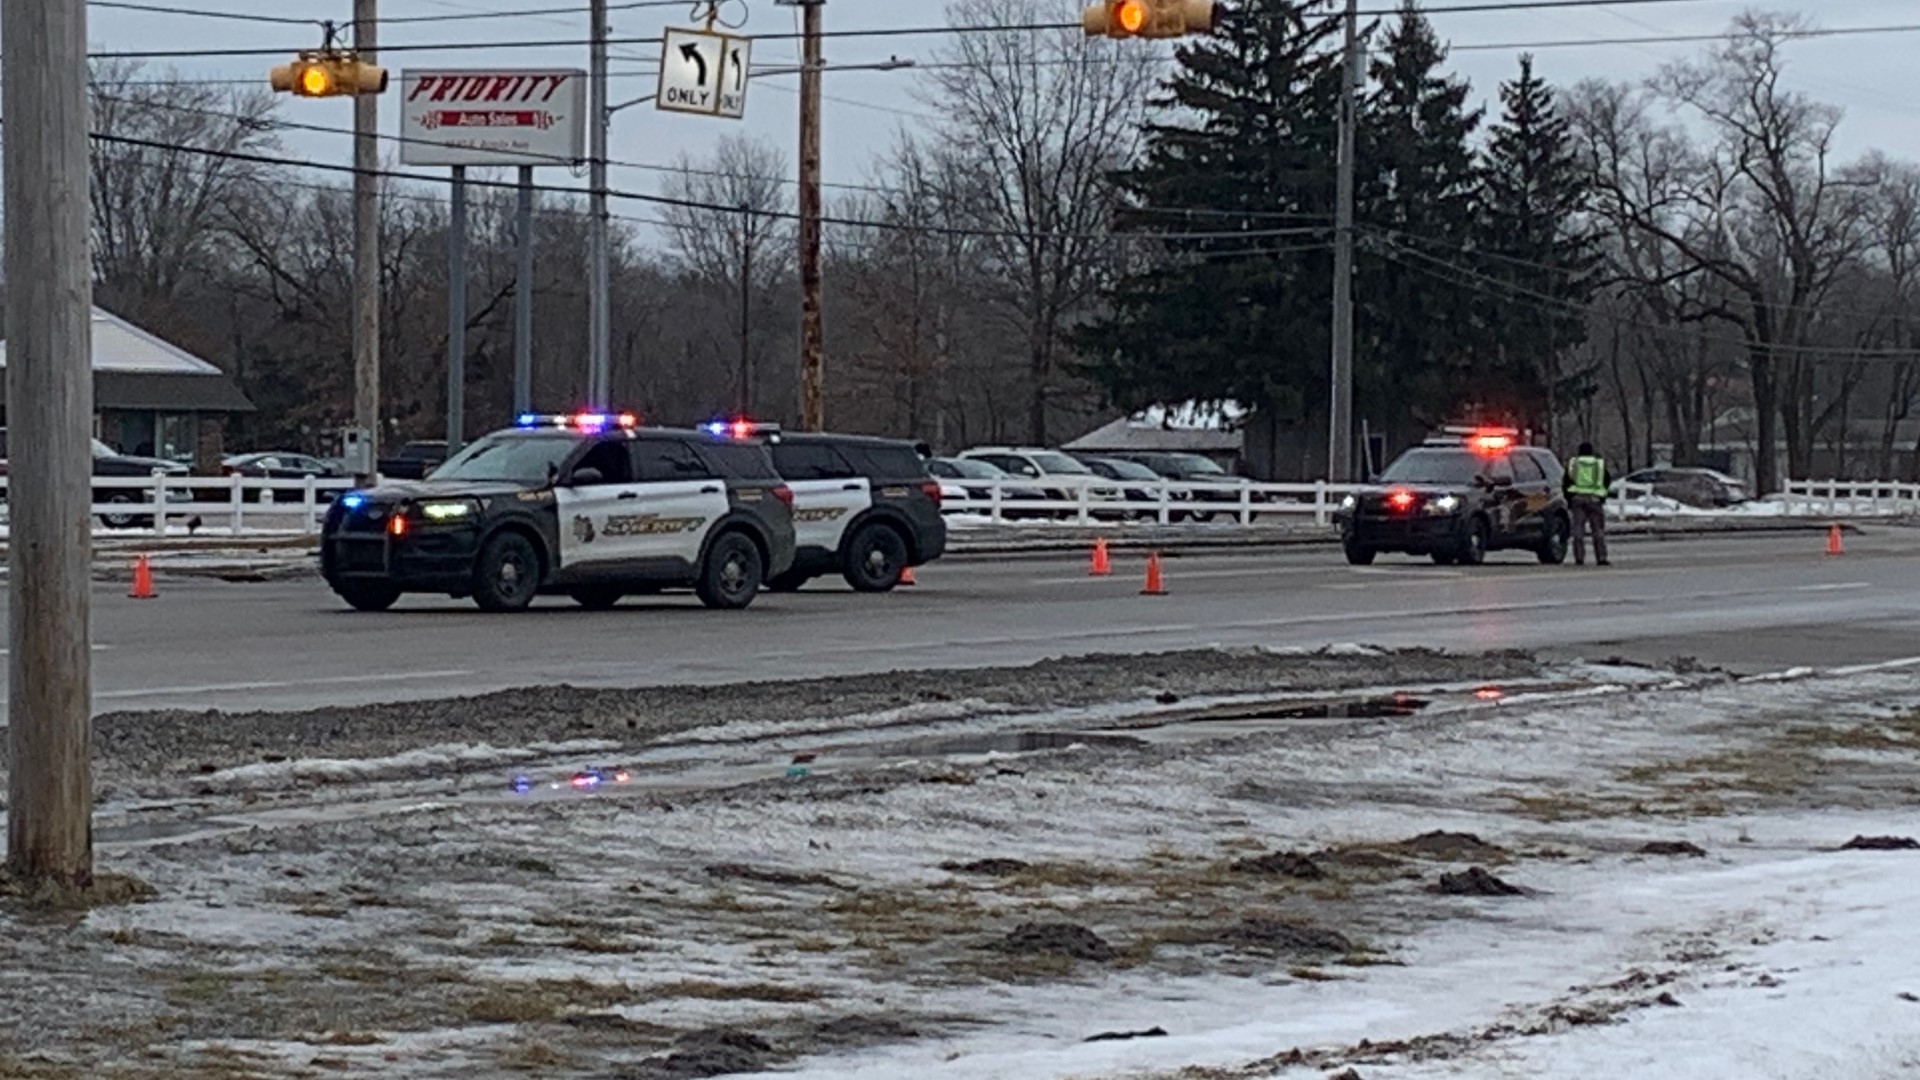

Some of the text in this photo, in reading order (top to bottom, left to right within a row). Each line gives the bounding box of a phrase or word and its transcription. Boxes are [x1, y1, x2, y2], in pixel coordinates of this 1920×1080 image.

[408, 75, 568, 102] PRIORITY
[667, 87, 710, 106] ONLY
[457, 112, 486, 126] Auto
